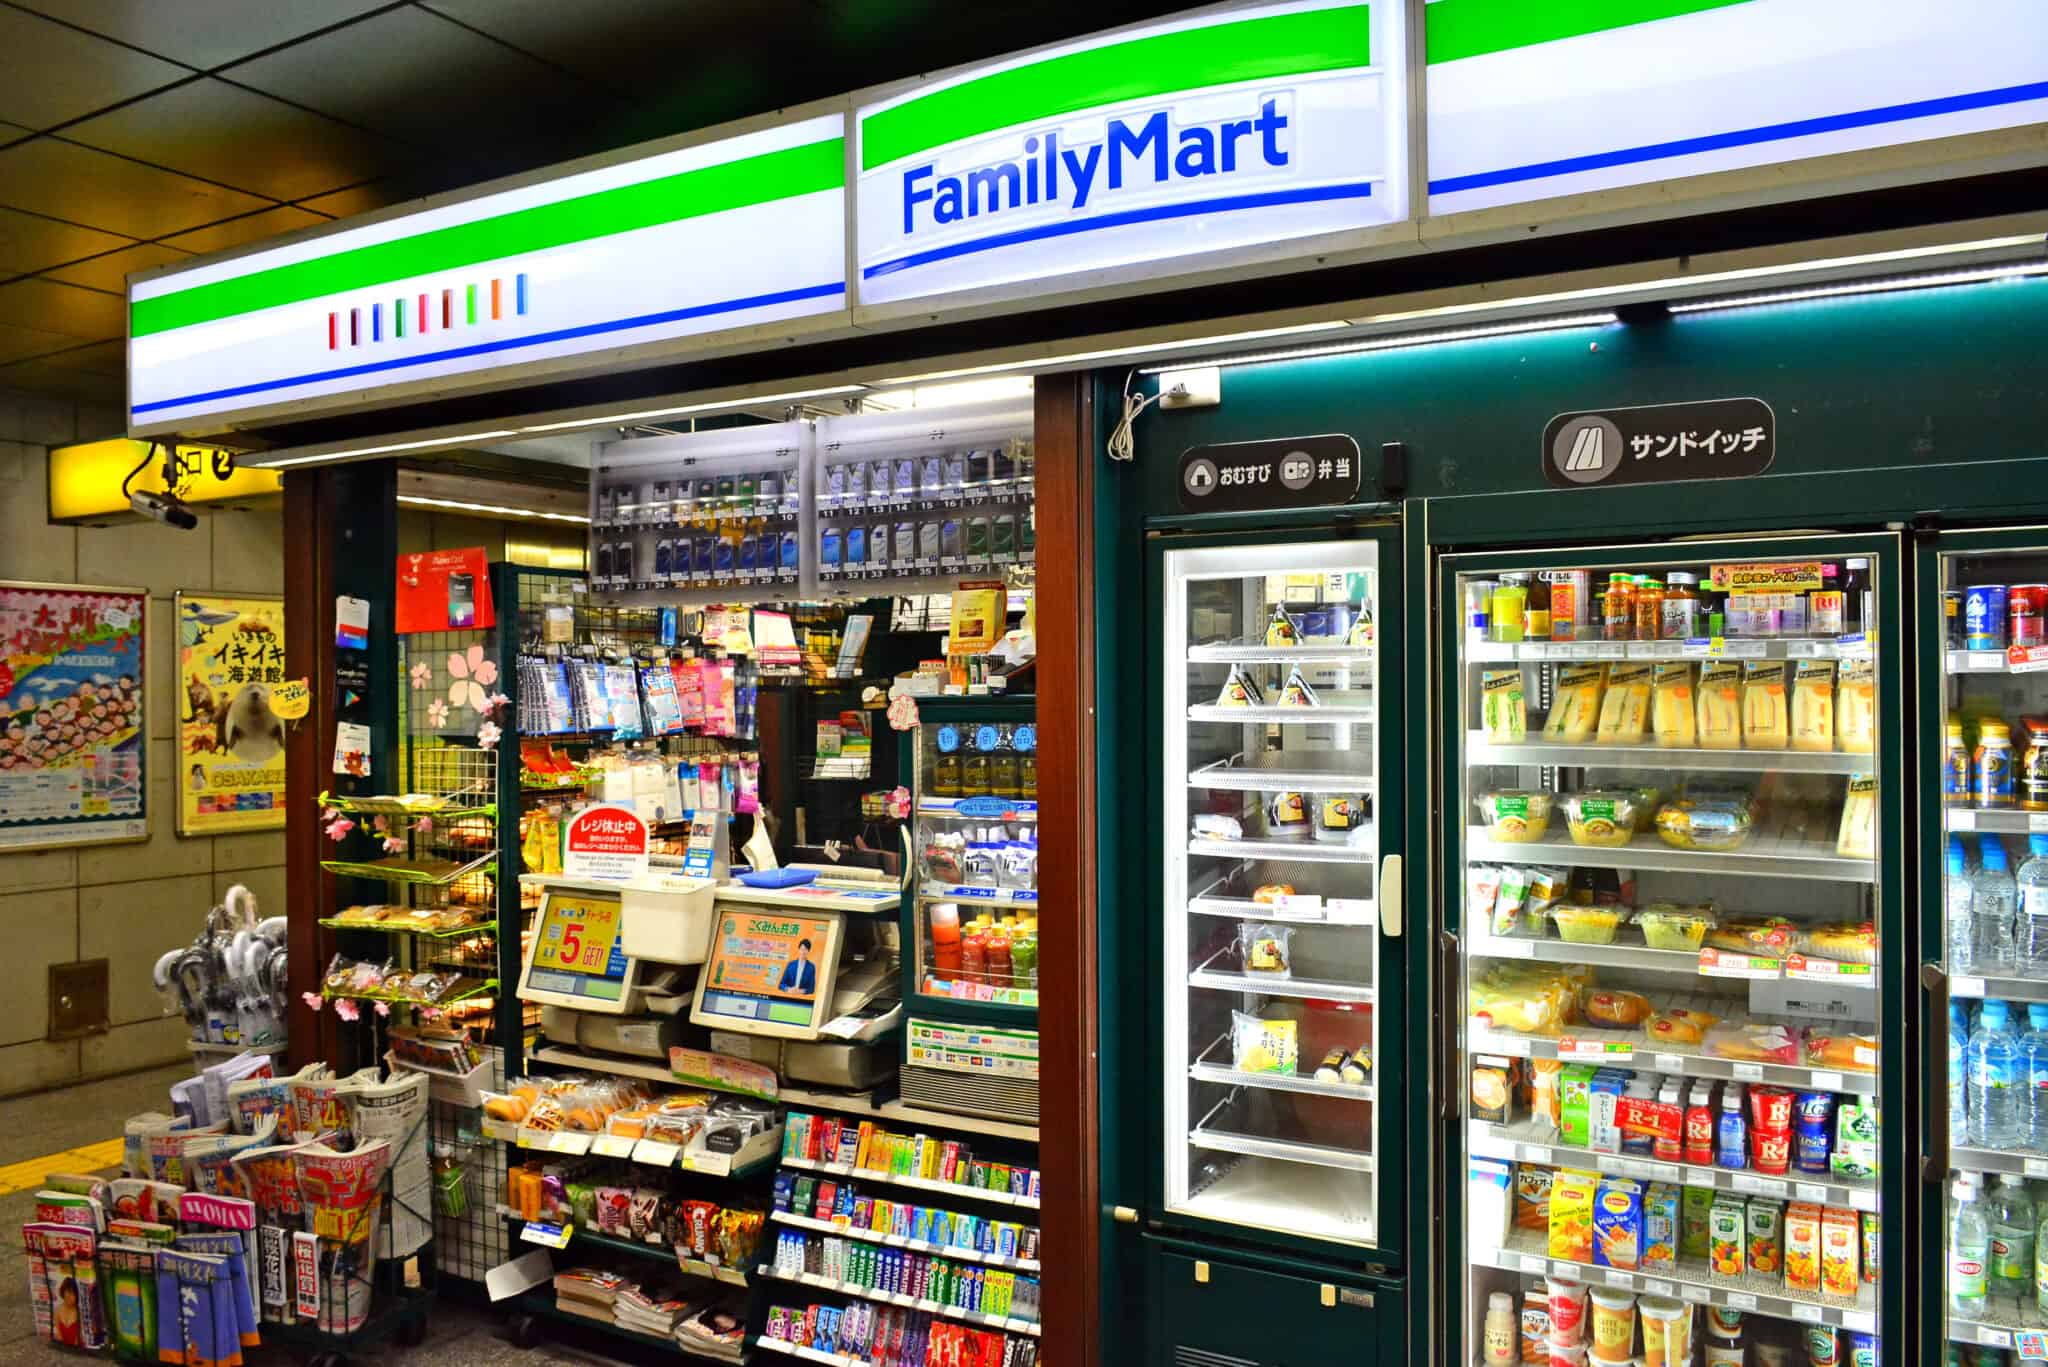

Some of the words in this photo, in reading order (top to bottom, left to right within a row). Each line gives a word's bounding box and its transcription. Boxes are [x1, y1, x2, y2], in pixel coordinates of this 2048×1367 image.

[904, 98, 1288, 234] FamilyMart
[1629, 426, 1767, 461] サンドイッチ
[1220, 465, 1272, 486] おむすび
[1317, 458, 1351, 480] 弁当
[580, 819, 637, 834] レジ休止中
[560, 923, 585, 964] 5
[1628, 1107, 1660, 1127] R-1
[1687, 1121, 1712, 1139] R-1
[1762, 1141, 1789, 1160] R-1
